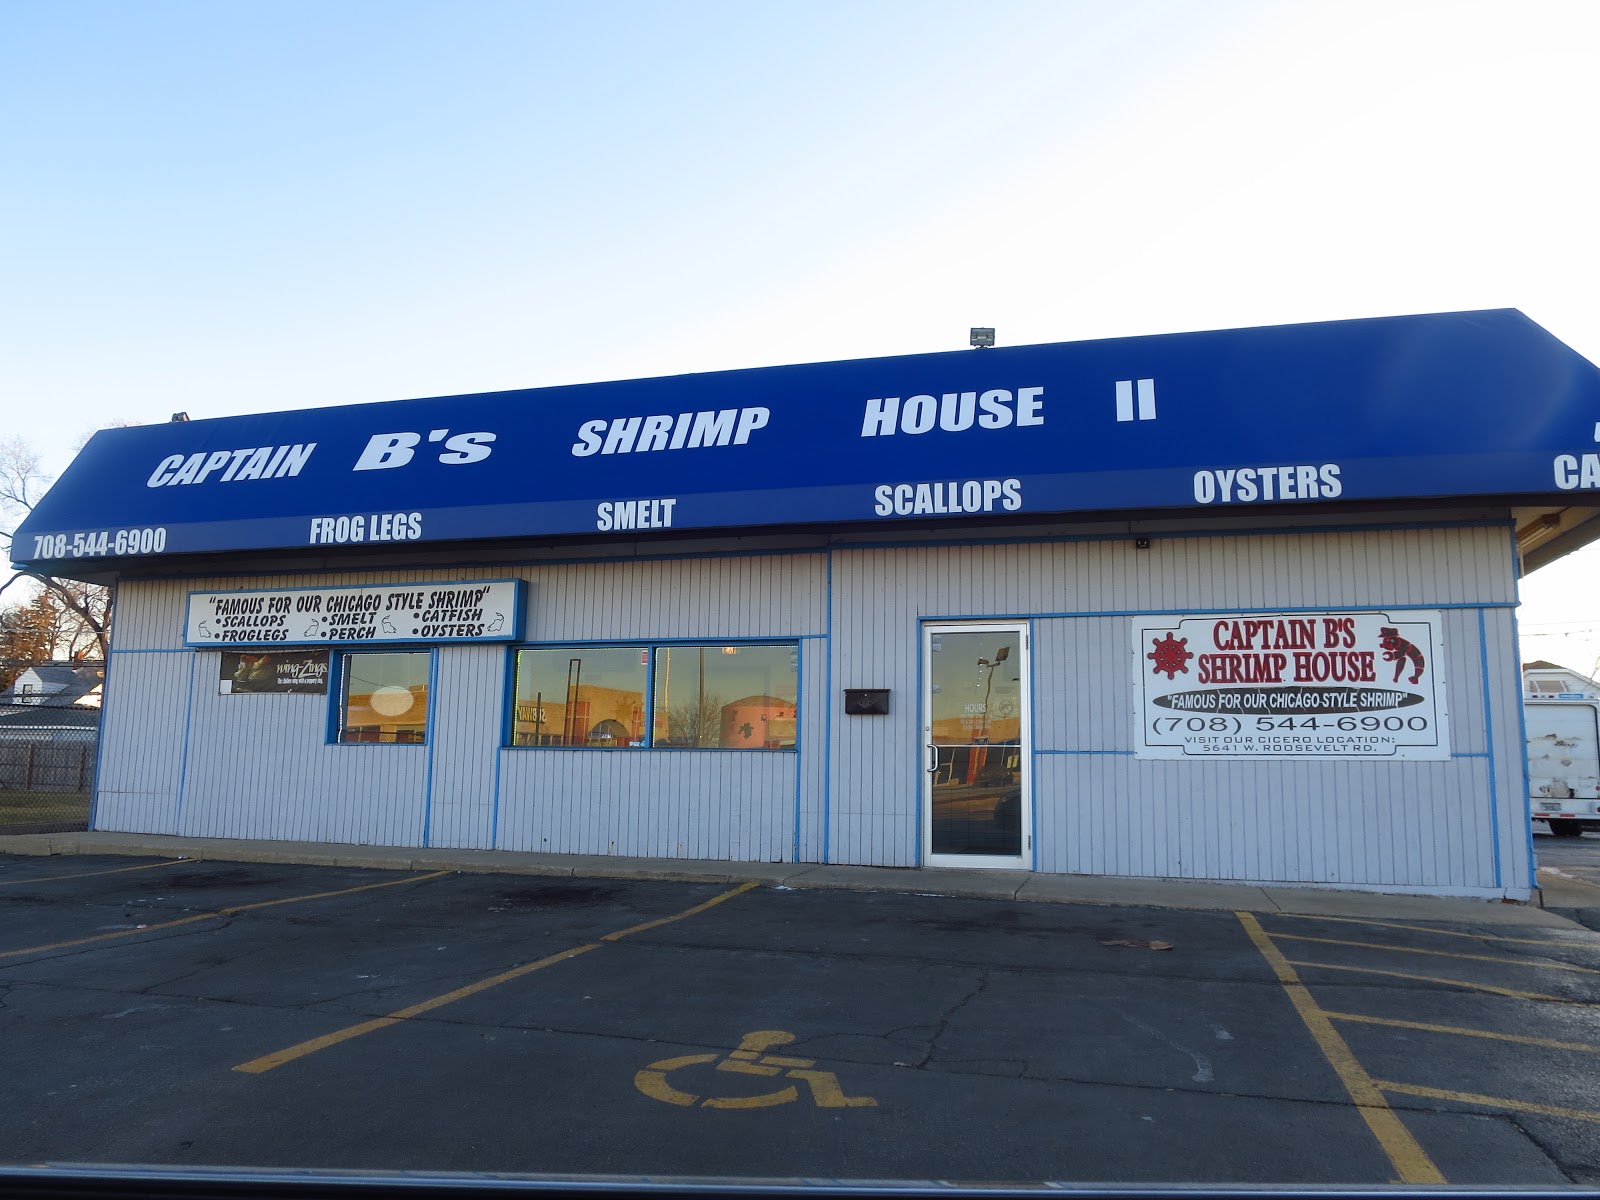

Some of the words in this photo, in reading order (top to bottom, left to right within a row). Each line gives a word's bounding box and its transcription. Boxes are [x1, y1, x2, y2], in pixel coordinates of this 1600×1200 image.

[147, 443, 317, 487] CAPTAIN
[572, 407, 769, 456] SHRIMP
[862, 387, 1043, 436] HOUSE
[1116, 379, 1156, 421] II
[1554, 454, 1600, 489] CA
[1194, 464, 1341, 503] OYSTERS
[875, 479, 1021, 516] SCALLOPS
[597, 499, 676, 530] SMELT
[309, 516, 365, 544] FROG
[369, 513, 422, 541] LEGS
[33, 528, 166, 559] 708-544-6900
[268, 596, 292, 614] FOR
[296, 595, 322, 613] OUR
[326, 594, 382, 613] CHICAGO
[386, 592, 424, 611] STYLE
[222, 615, 287, 628] SCALLOPS
[329, 612, 377, 626] SMELT
[421, 608, 483, 623] CATFISH
[222, 629, 289, 642] FROGLEGS
[329, 626, 377, 640] PERCH
[421, 624, 485, 638] OYSTERS
[1213, 619, 1317, 651] CAPTAIN
[1323, 617, 1357, 649] B'S
[1198, 653, 1288, 684] SHRIMP
[1293, 651, 1377, 682] HOUSE
[965, 703, 987, 713] HOURS
[1219, 693, 1241, 709] FOR
[1243, 693, 1268, 709] OUR
[1152, 717, 1242, 735] (708)
[1256, 716, 1428, 732] 544-6900
[1184, 736, 1220, 744] VISIT
[1223, 736, 1254, 744] OUR
[1258, 736, 1312, 744] CICERO
[1316, 736, 1396, 744] LOCATION:
